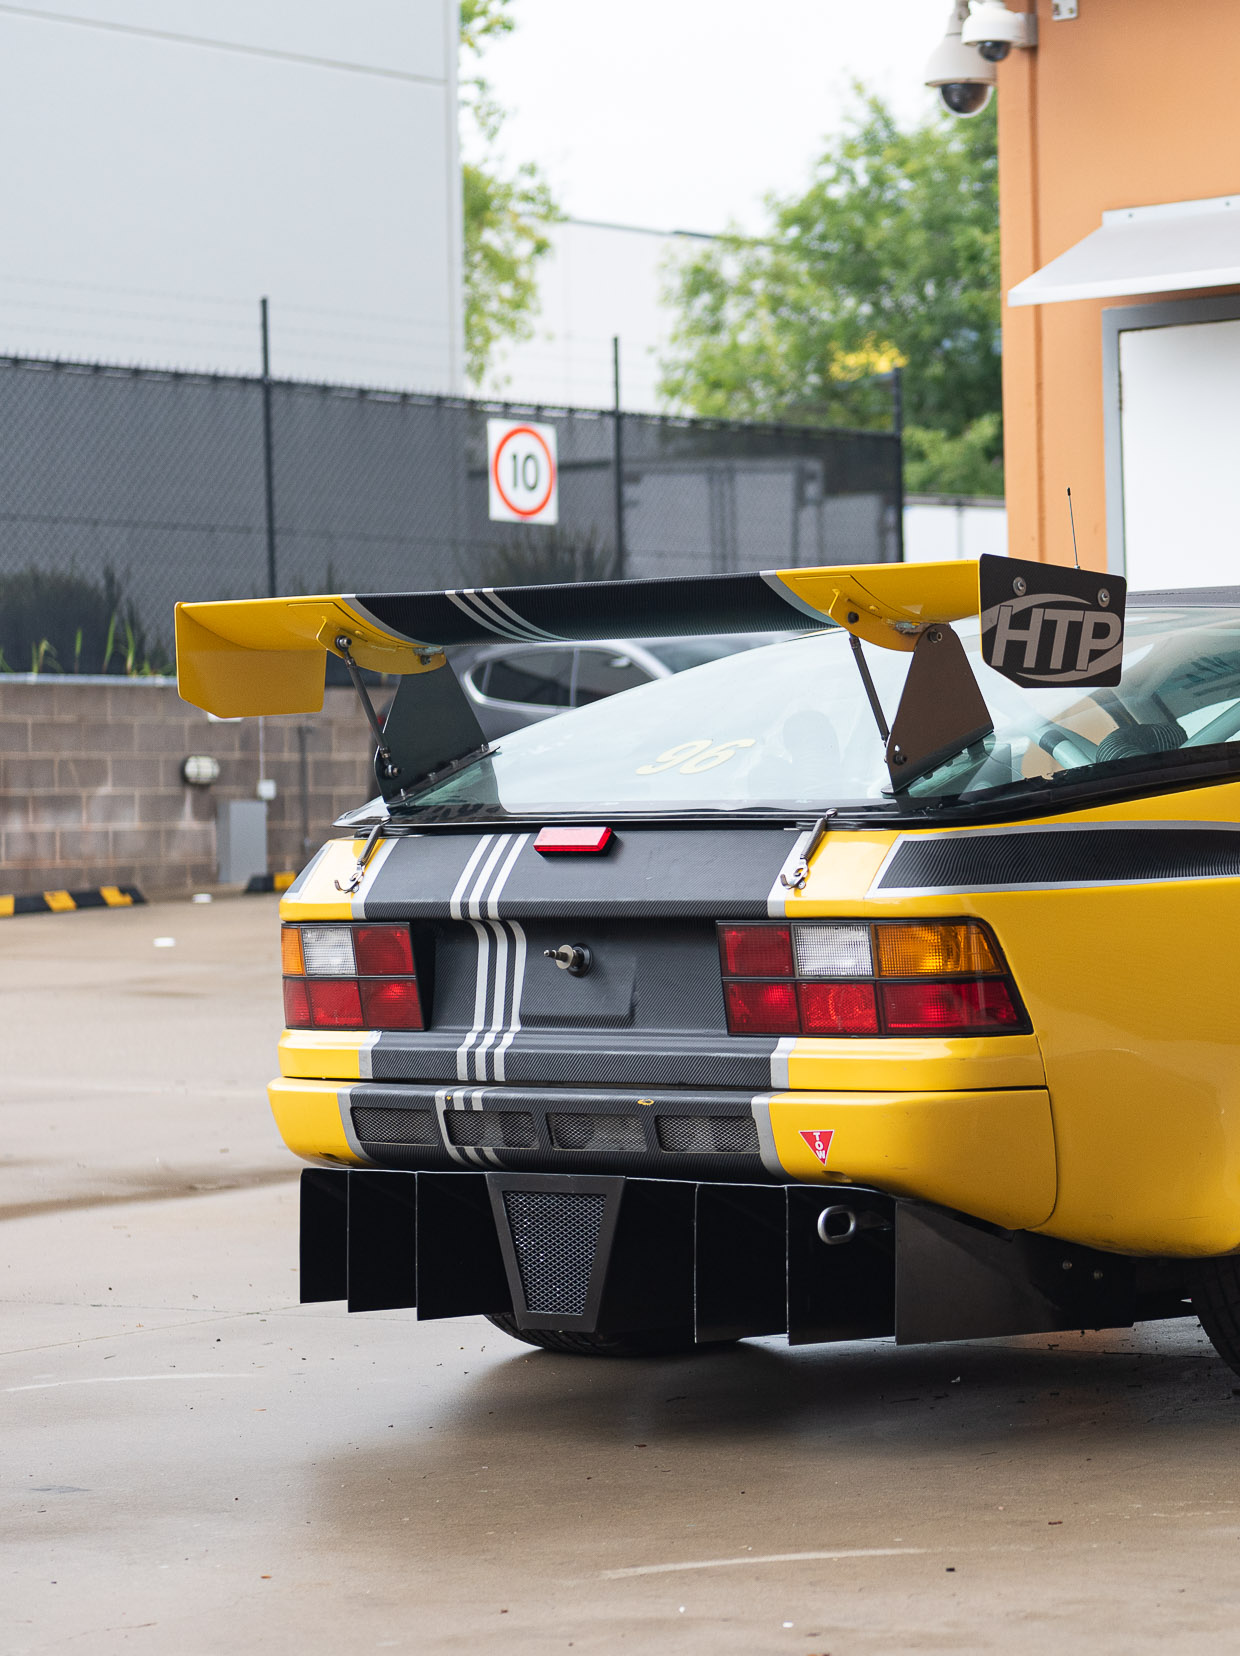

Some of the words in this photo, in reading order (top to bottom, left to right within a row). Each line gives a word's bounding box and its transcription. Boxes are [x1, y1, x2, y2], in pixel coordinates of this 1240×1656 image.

[511, 453, 539, 490] 10
[991, 605, 1121, 671] HTP
[635, 739, 756, 775] 96
[813, 1132, 825, 1159] TOW
